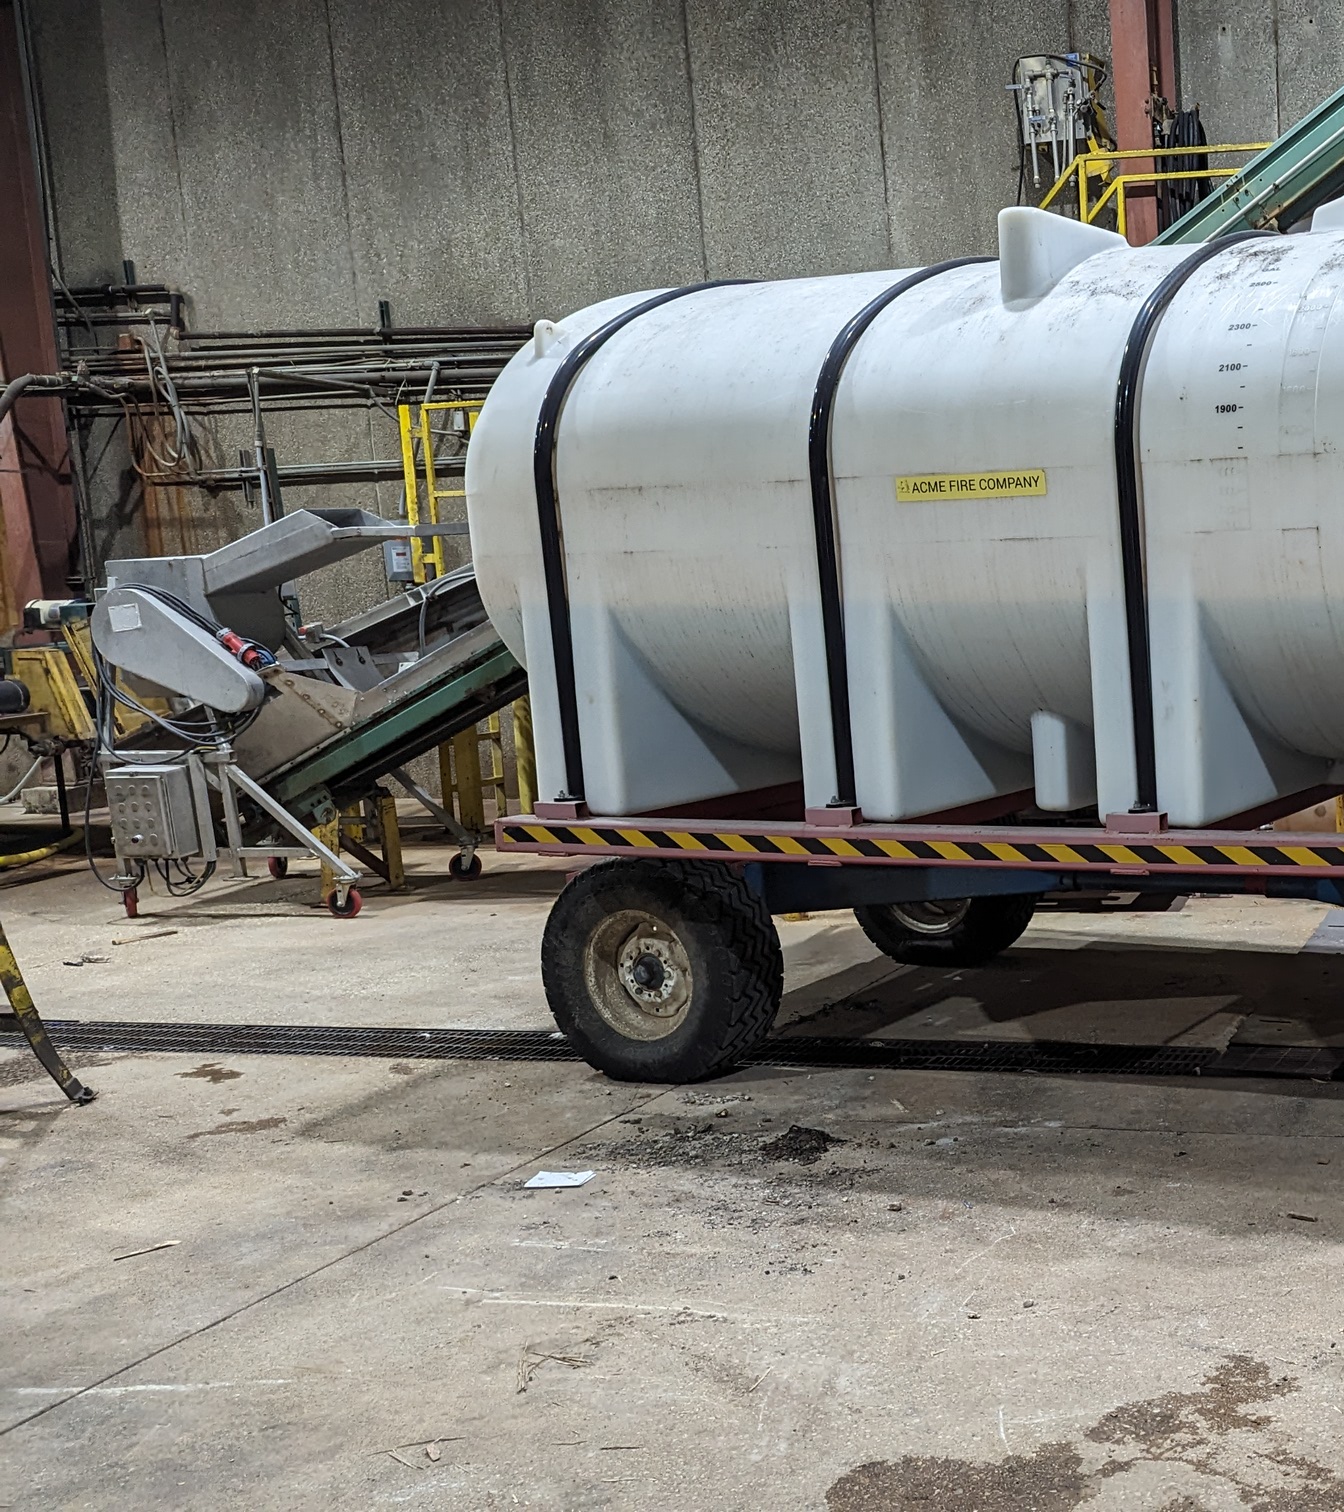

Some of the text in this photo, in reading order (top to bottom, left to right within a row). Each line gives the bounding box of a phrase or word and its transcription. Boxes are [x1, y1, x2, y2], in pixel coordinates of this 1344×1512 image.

[1228, 322, 1251, 331] 2300
[1218, 363, 1242, 372] 2100
[1215, 404, 1238, 414] 1900
[911, 475, 1040, 494] ACME FIRE COMPANY
